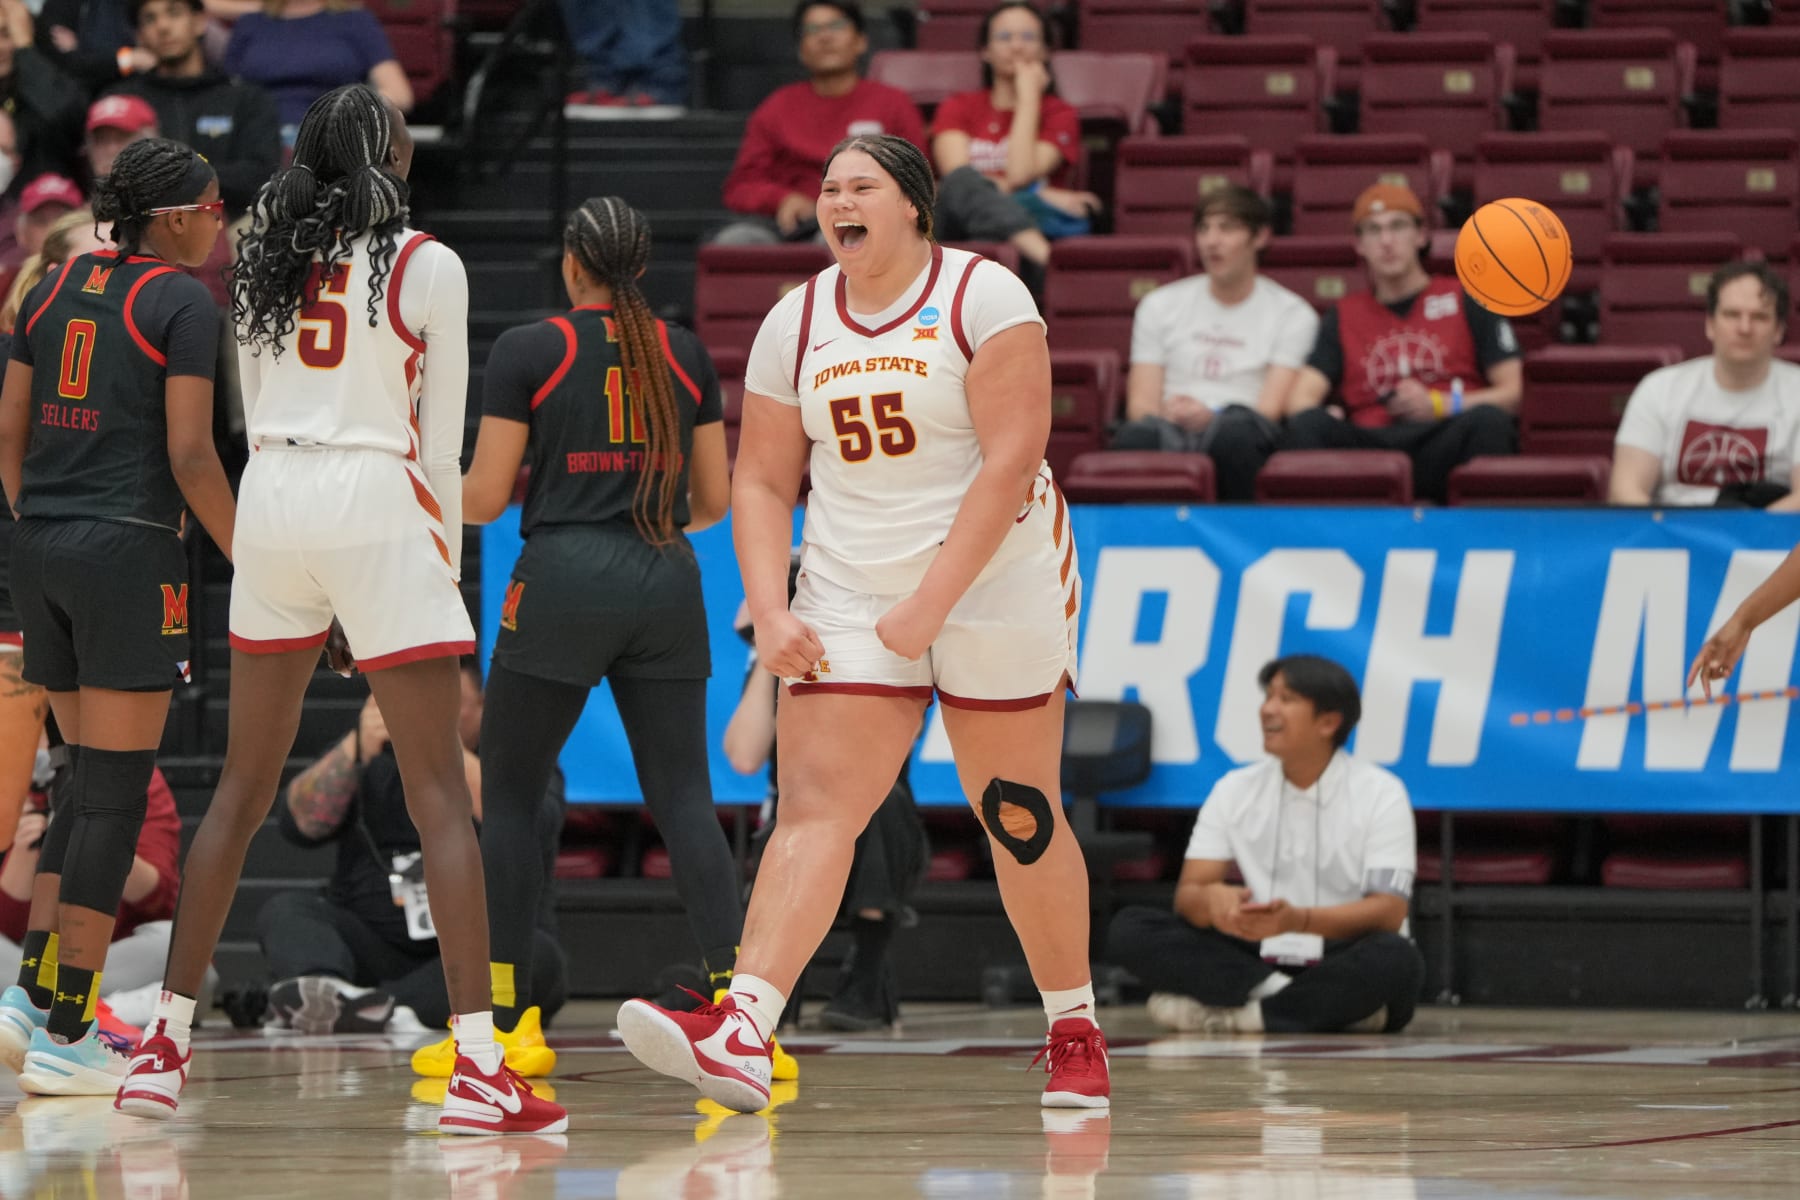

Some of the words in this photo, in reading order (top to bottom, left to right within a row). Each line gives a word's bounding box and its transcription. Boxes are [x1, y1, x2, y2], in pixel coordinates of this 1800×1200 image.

[297, 261, 352, 370] 5
[58, 318, 96, 400] 0
[813, 358, 862, 391] IOWA
[865, 355, 929, 378] STATE
[41, 403, 100, 432] SELLERS
[829, 390, 917, 464] 55
